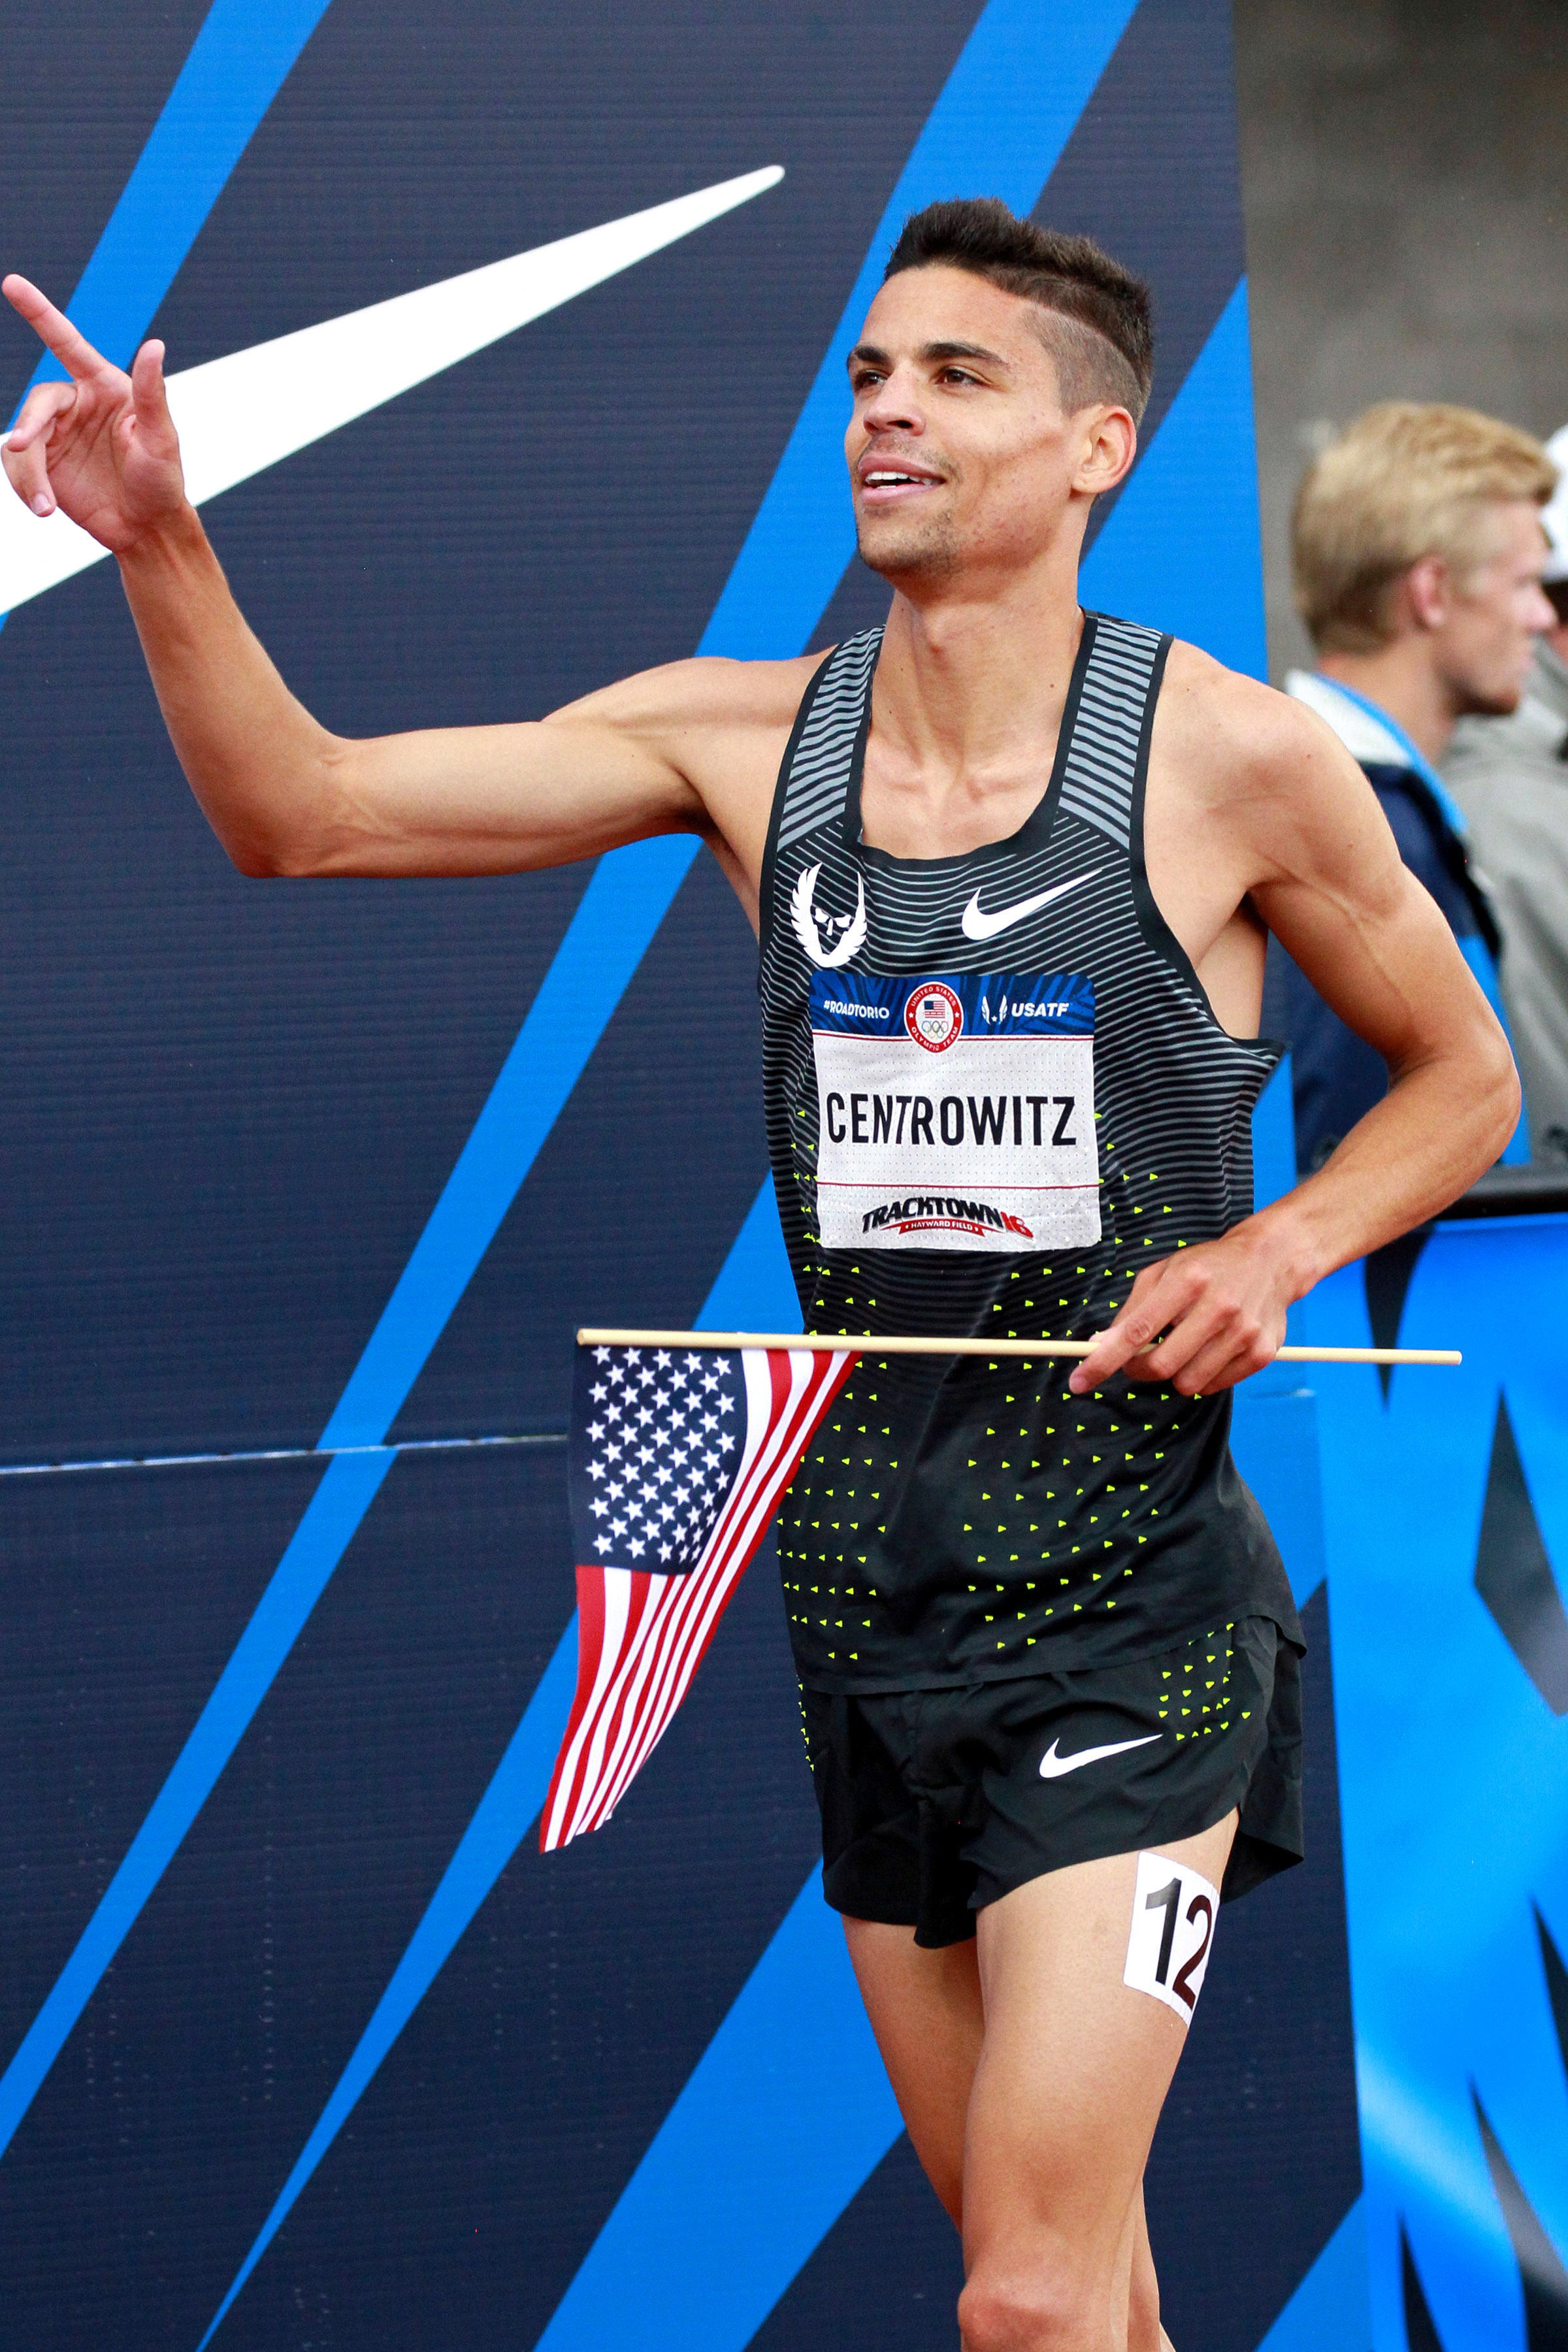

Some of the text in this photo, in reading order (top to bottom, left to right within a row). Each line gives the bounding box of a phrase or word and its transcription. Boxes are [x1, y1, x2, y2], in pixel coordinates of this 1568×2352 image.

[911, 986, 956, 1007] UNITED STATES
[823, 999, 890, 1019] #ROADTORIO
[1011, 1002, 1070, 1017] USATF
[911, 1026, 958, 1051] OLYMPIC TEAM
[826, 1092, 1077, 1146] CENTROWITZ
[911, 1220, 973, 1230] HAYWARD FIELD
[1145, 1877, 1213, 2012] 12
